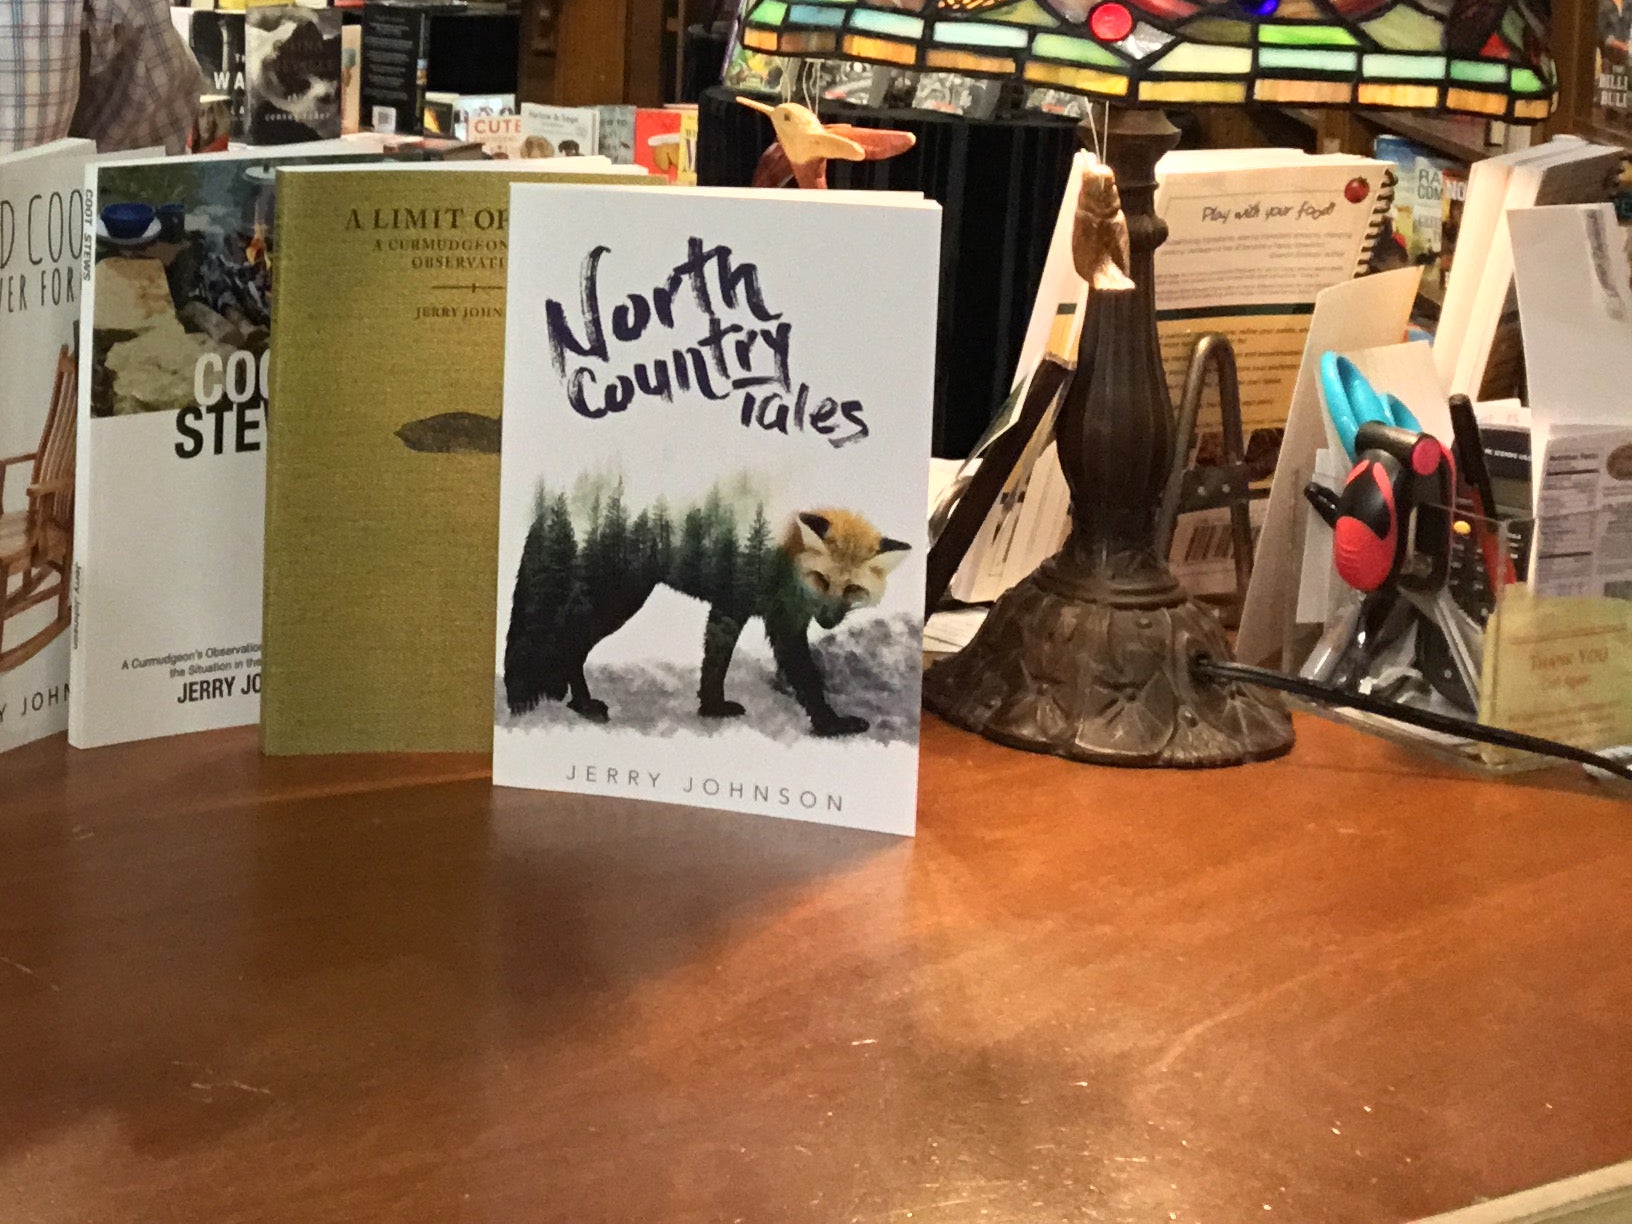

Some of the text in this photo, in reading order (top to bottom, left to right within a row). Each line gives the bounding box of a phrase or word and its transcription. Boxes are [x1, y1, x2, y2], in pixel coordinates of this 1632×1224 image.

[27, 188, 84, 266] COO
[345, 207, 362, 231] A
[371, 207, 465, 231] LIMIT
[1201, 201, 1337, 224] Play with your food
[82, 188, 94, 282] COOT STEWS
[371, 237, 509, 252] A CURMUDGEON
[410, 255, 506, 271] OBSERVATI
[40, 265, 75, 307] FOR
[415, 305, 503, 321] JERRY JOHN
[544, 236, 783, 382] North
[193, 348, 271, 406] CO
[566, 316, 792, 419] Country
[174, 400, 268, 459] STE
[732, 374, 870, 448] Tales
[121, 659, 130, 670] A
[131, 649, 204, 670] Curmudgeon's
[169, 667, 186, 679] the
[188, 660, 233, 676] Situation
[234, 658, 244, 669] in
[20, 682, 71, 716] JOHN
[176, 672, 262, 704] JERRY JO
[565, 764, 846, 813] JERRY JOHNSON
